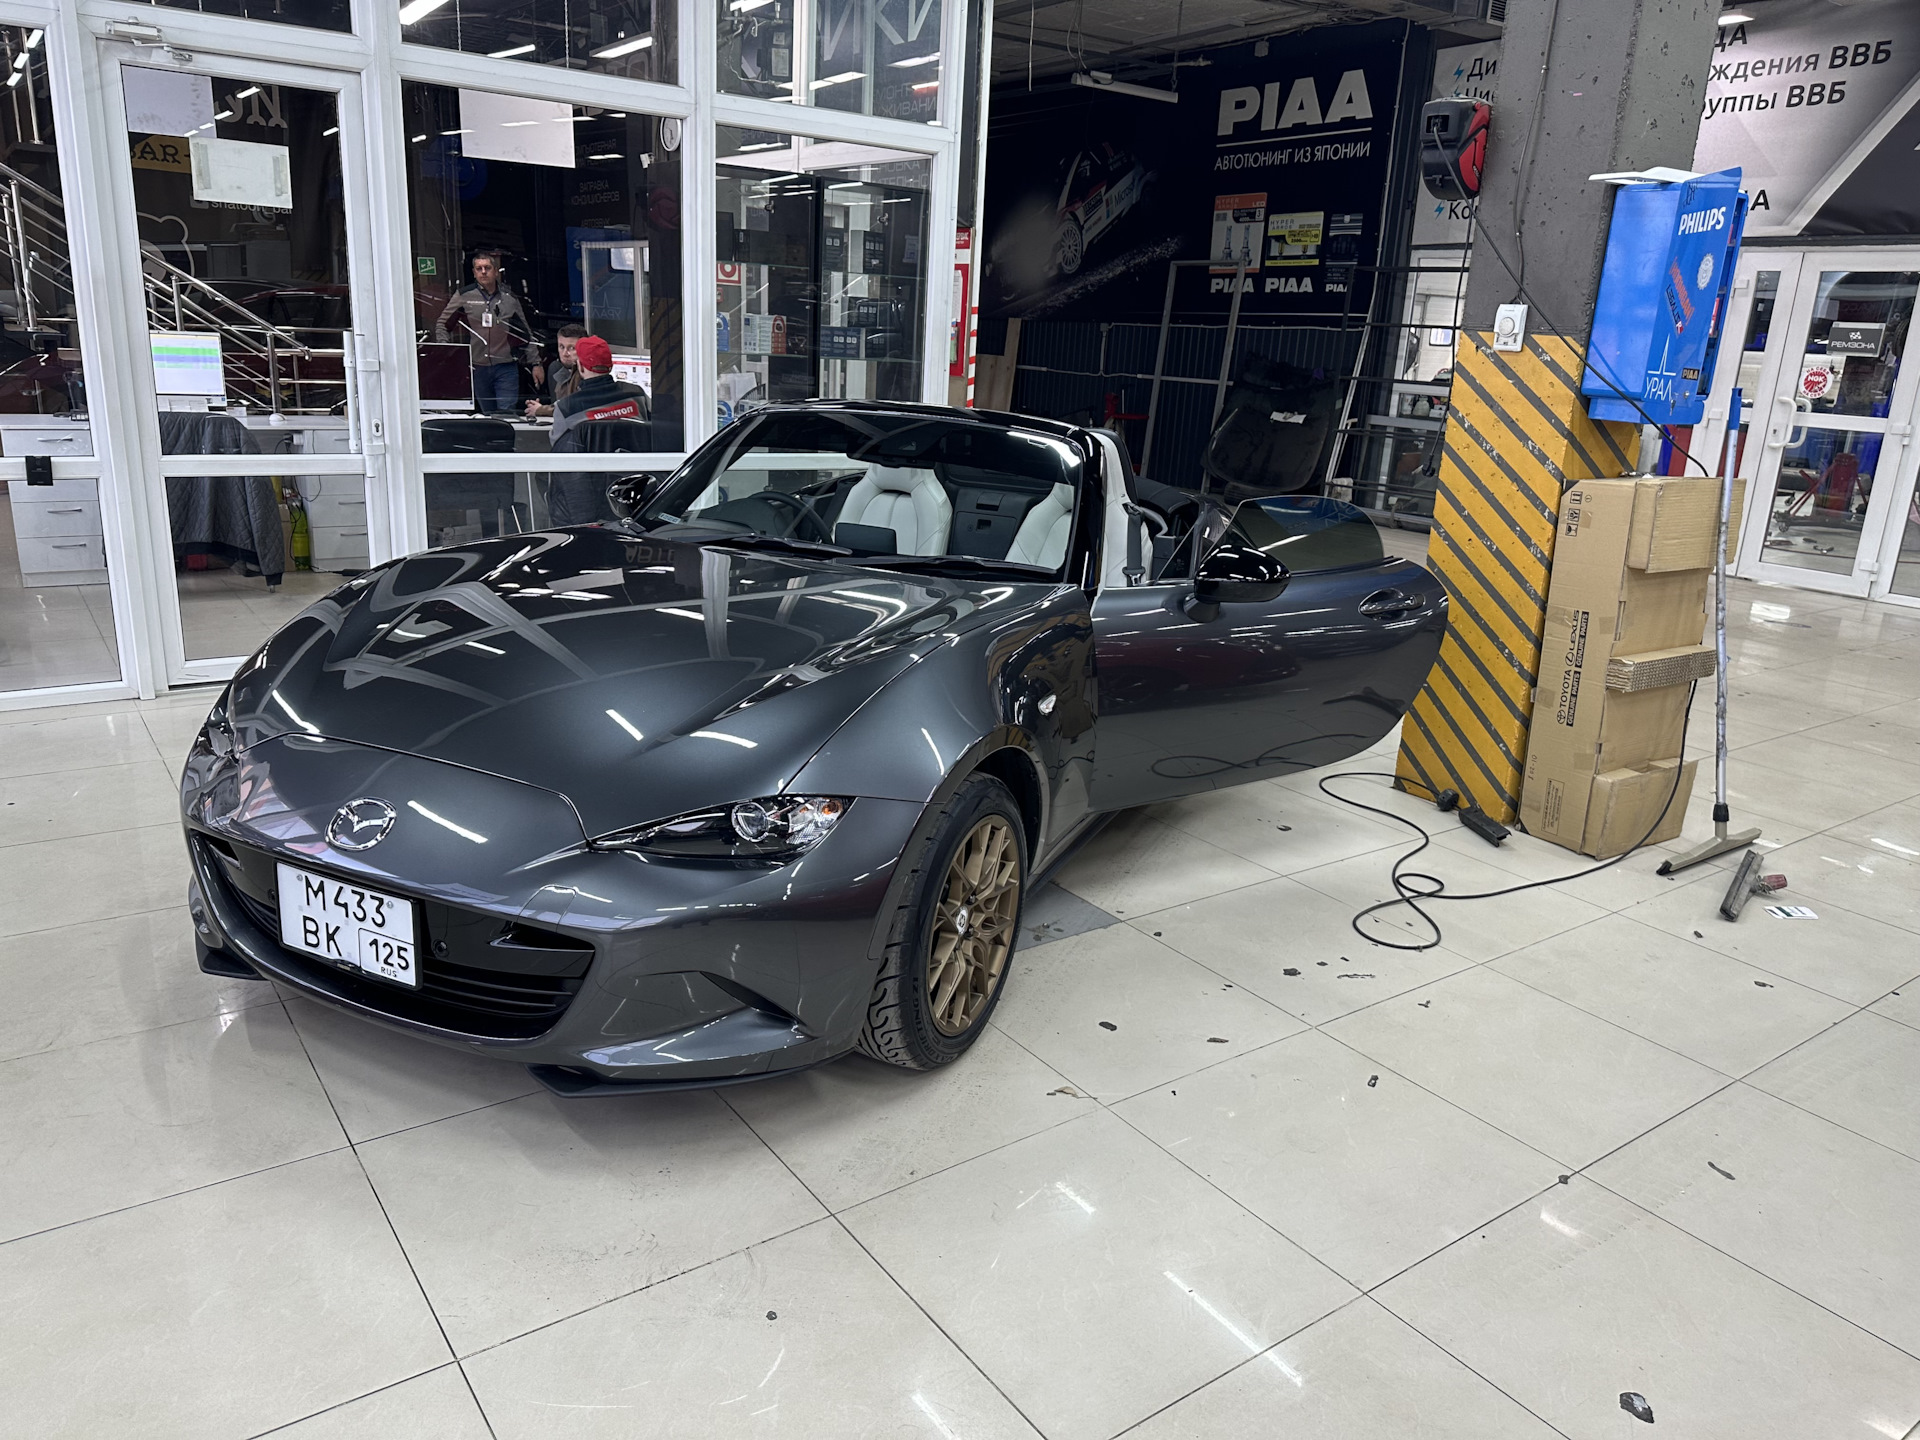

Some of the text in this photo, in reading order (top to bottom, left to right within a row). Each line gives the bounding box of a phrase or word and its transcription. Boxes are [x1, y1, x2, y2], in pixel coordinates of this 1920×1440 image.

[1828, 39, 1893, 69] ВВБ
[1217, 68, 1373, 136] PIAA
[1702, 80, 1847, 120] уппы ВВБ
[1214, 141, 1371, 171] АВТОТЮНИНГ ИЗ ЯПОНИИ
[1677, 206, 1727, 236] PHILIPS
[1264, 277, 1313, 293] PIAA
[1325, 283, 1348, 293] PIA
[1830, 340, 1876, 349] РЕМЗОНА
[1644, 377, 1672, 402] УРАЛ
[1682, 369, 1699, 381] PIAA
[594, 406, 634, 420] ШИНТОП
[1568, 609, 1580, 651] LEXUS
[1576, 613, 1588, 666] GENUINE PARTS
[1559, 669, 1572, 708] TOYOTA
[1567, 672, 1580, 725] GENUINE PARTS
[333, 886, 386, 928] 433
[368, 938, 410, 971] 125
[380, 966, 398, 978] RUS
